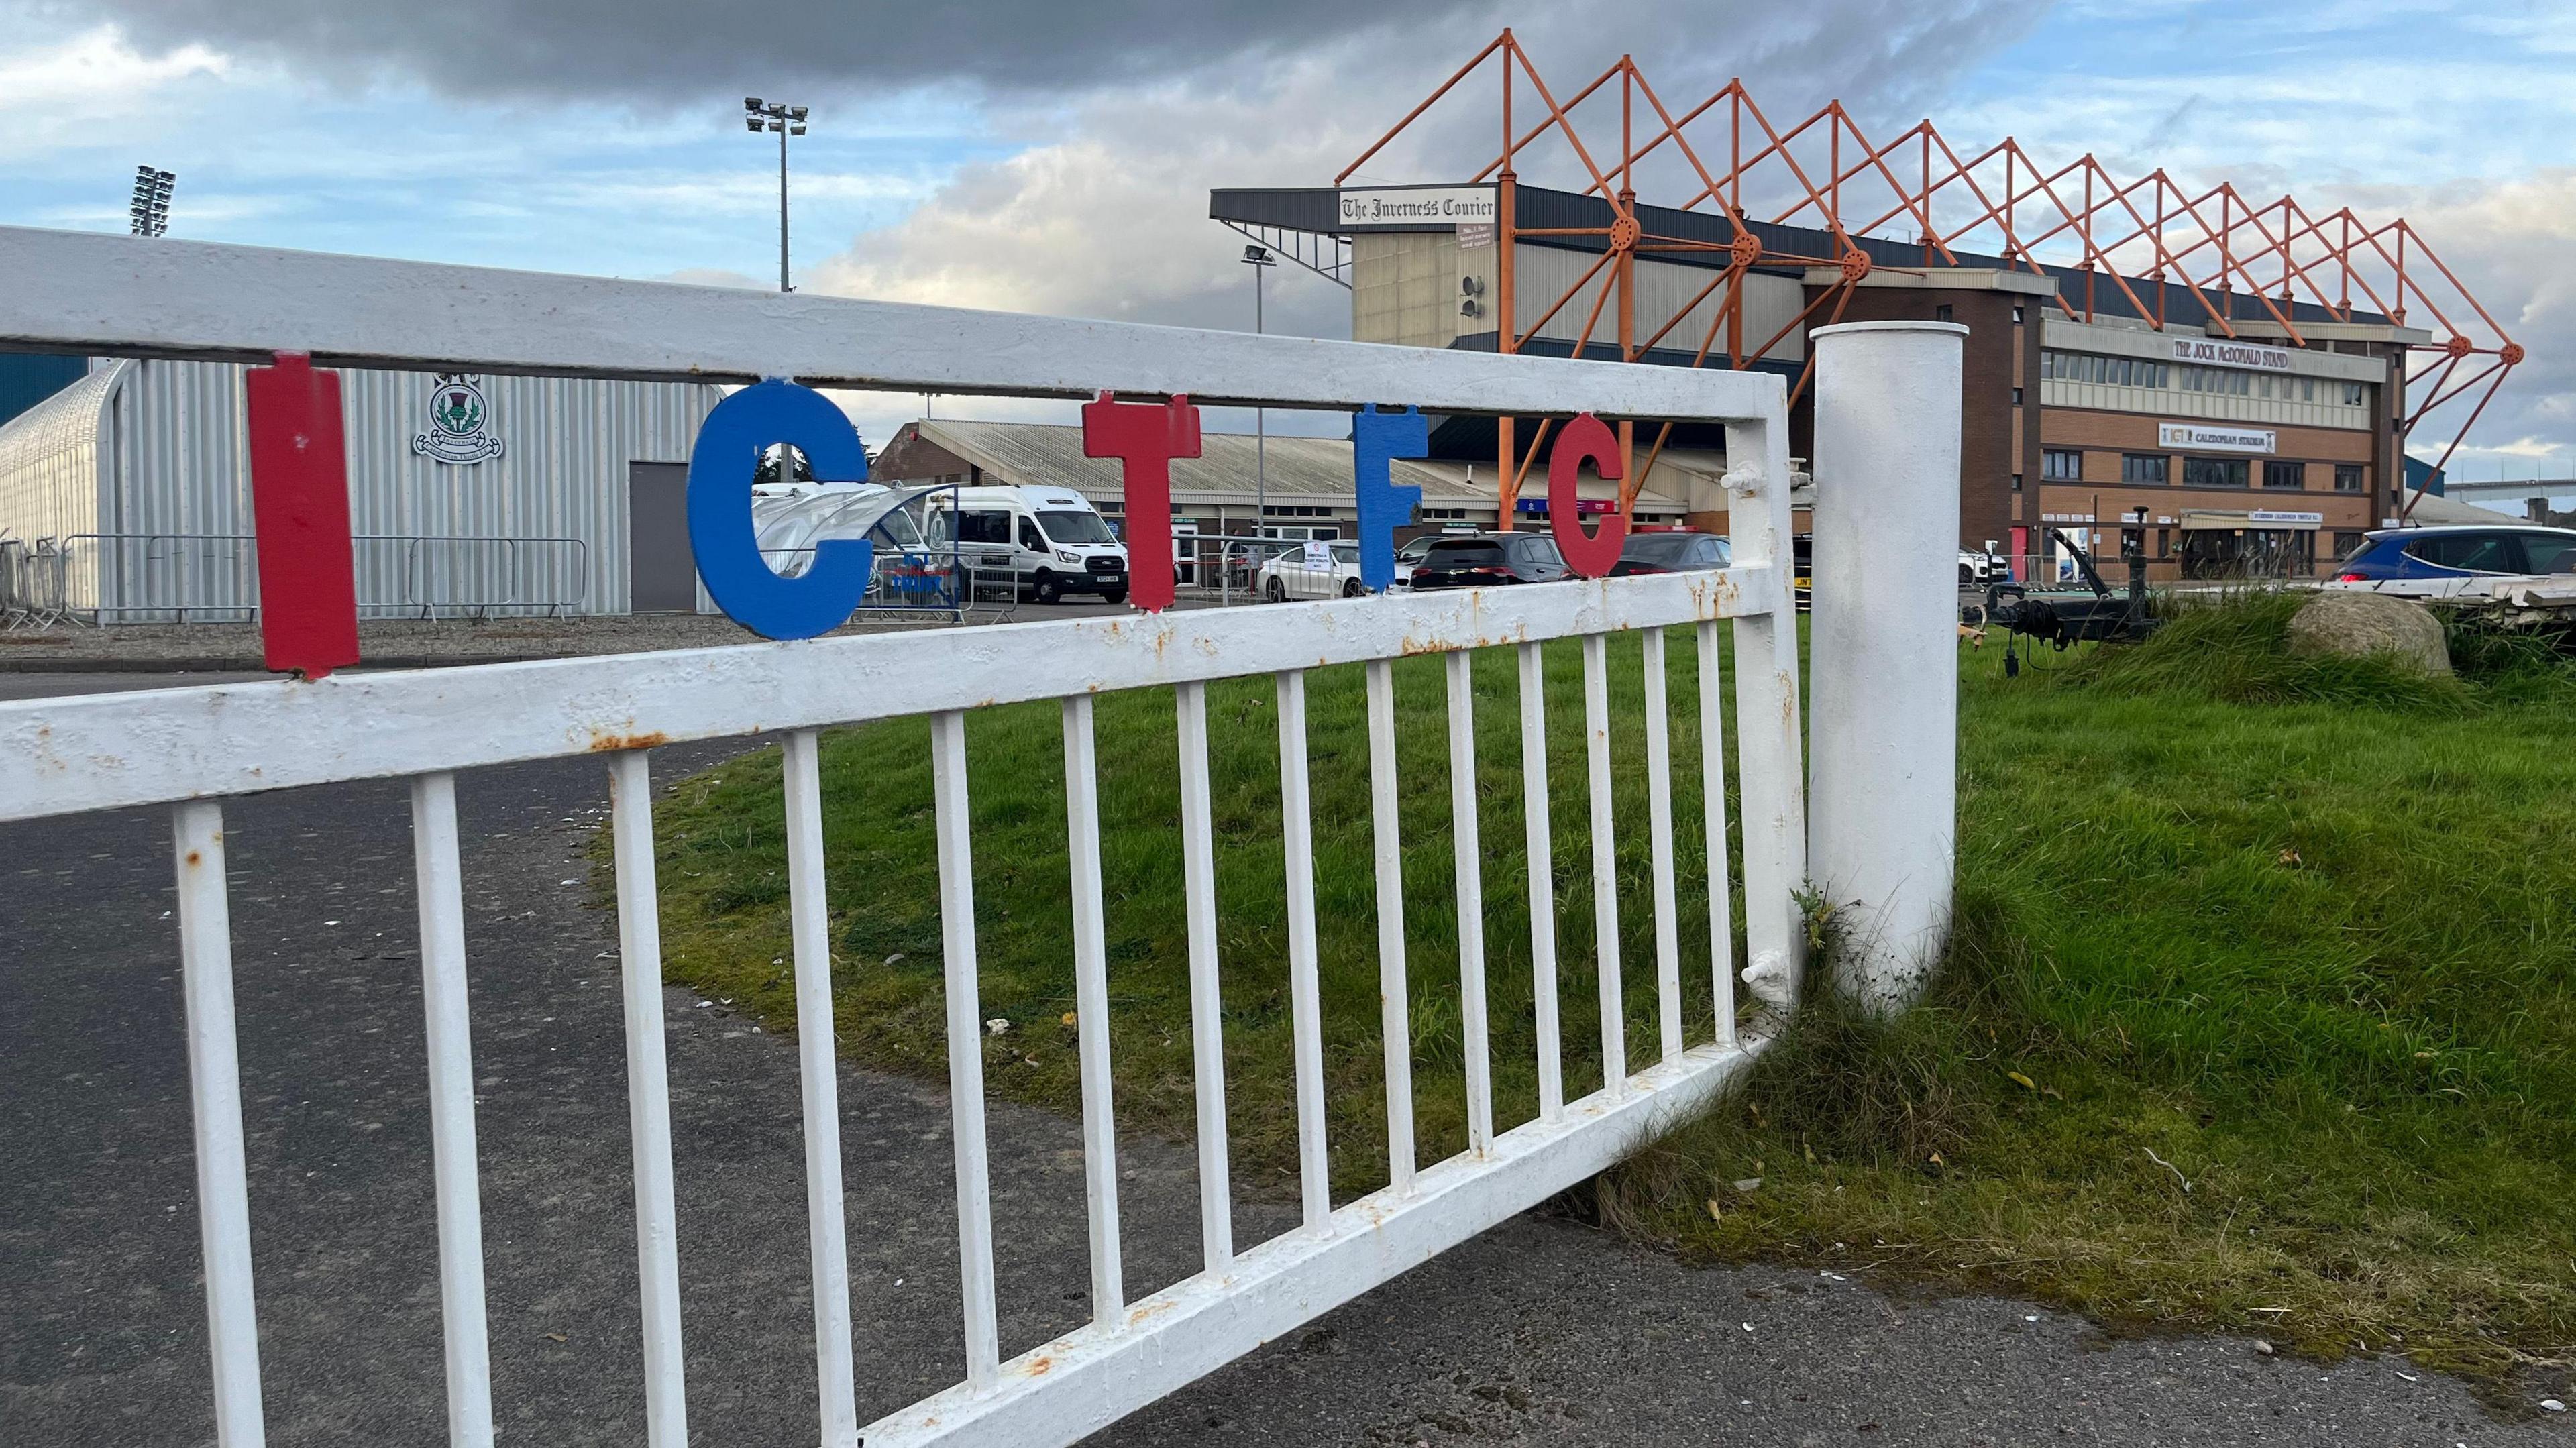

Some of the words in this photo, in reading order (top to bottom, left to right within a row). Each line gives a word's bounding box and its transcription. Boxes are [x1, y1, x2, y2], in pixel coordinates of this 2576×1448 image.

[1342, 199, 1366, 221] The
[1371, 199, 1438, 221] Inverness
[1443, 197, 1493, 215] Courier
[1474, 239, 1490, 248] sport
[2175, 341, 2191, 358] THE
[2194, 343, 2215, 361] JOCK
[2218, 346, 2261, 366] McDONALD
[2263, 351, 2288, 368] STAND
[443, 437, 476, 445] Inverness
[2196, 433, 2237, 445] CALEDONIAN
[425, 444, 458, 459] Caledonian
